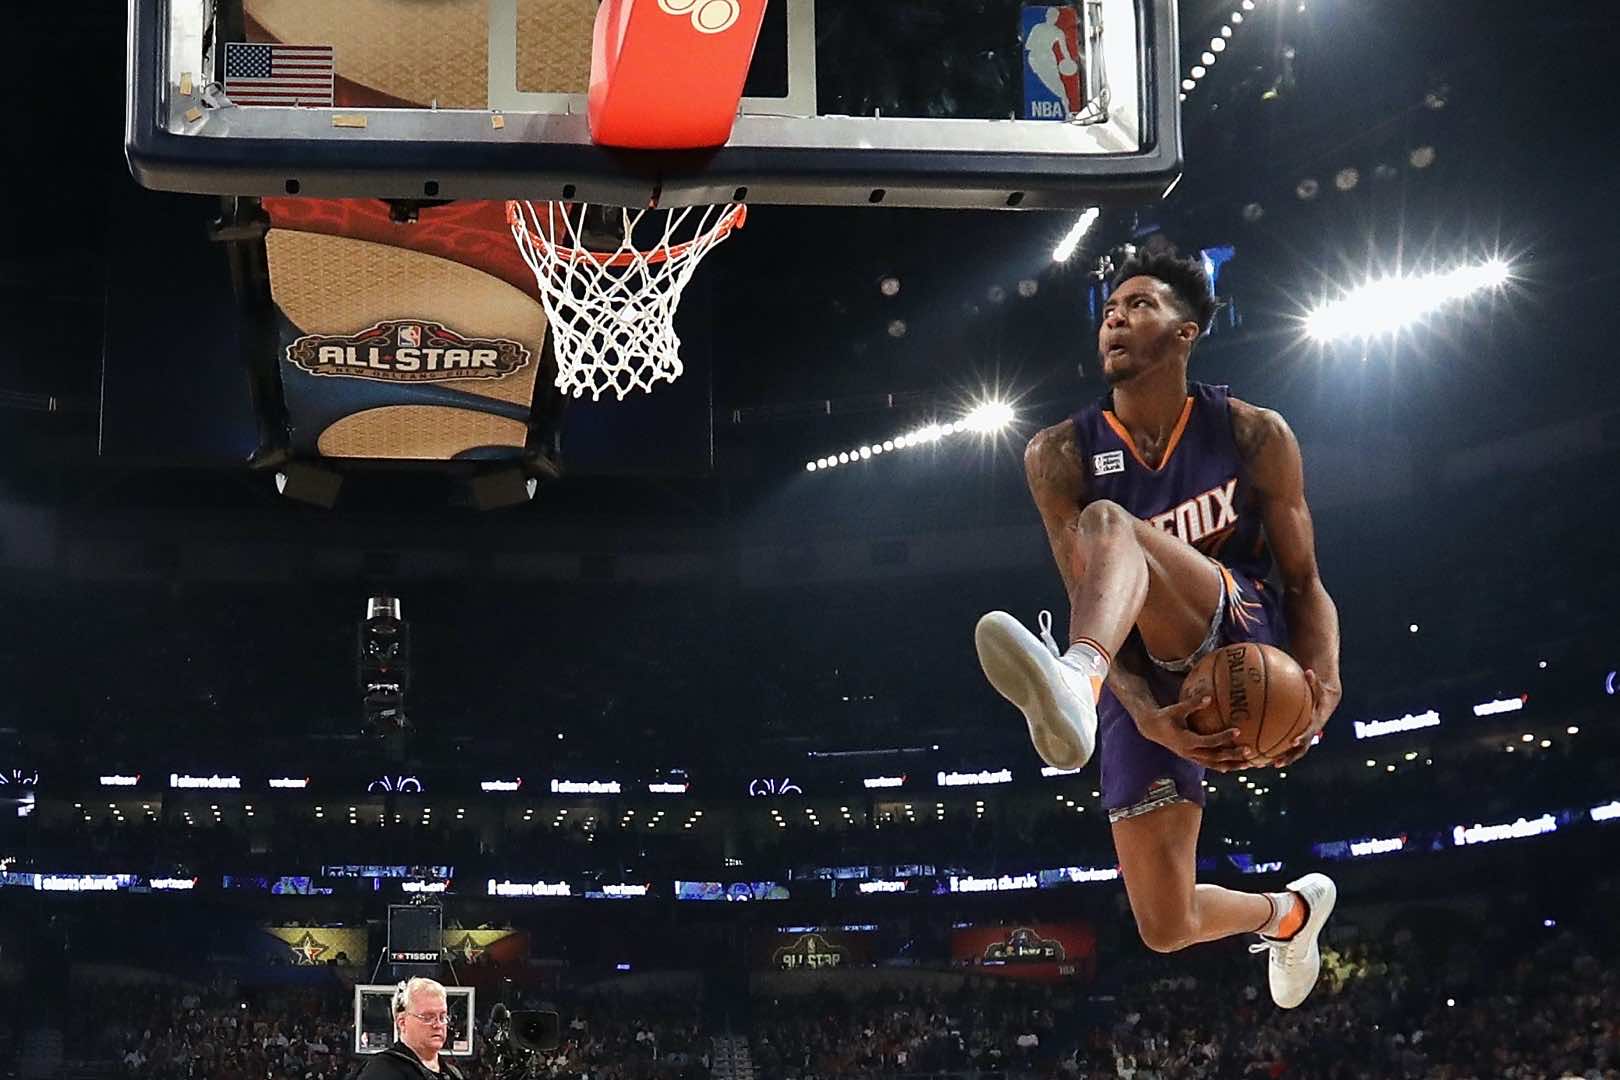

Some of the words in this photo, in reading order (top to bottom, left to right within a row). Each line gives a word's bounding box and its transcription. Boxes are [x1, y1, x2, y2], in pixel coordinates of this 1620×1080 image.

[1031, 101, 1063, 117] NBA
[395, 349, 497, 372] STAR
[1144, 477, 1239, 543] ENIX
[1226, 647, 1249, 722] PALDING
[405, 952, 438, 961] TISSOT
